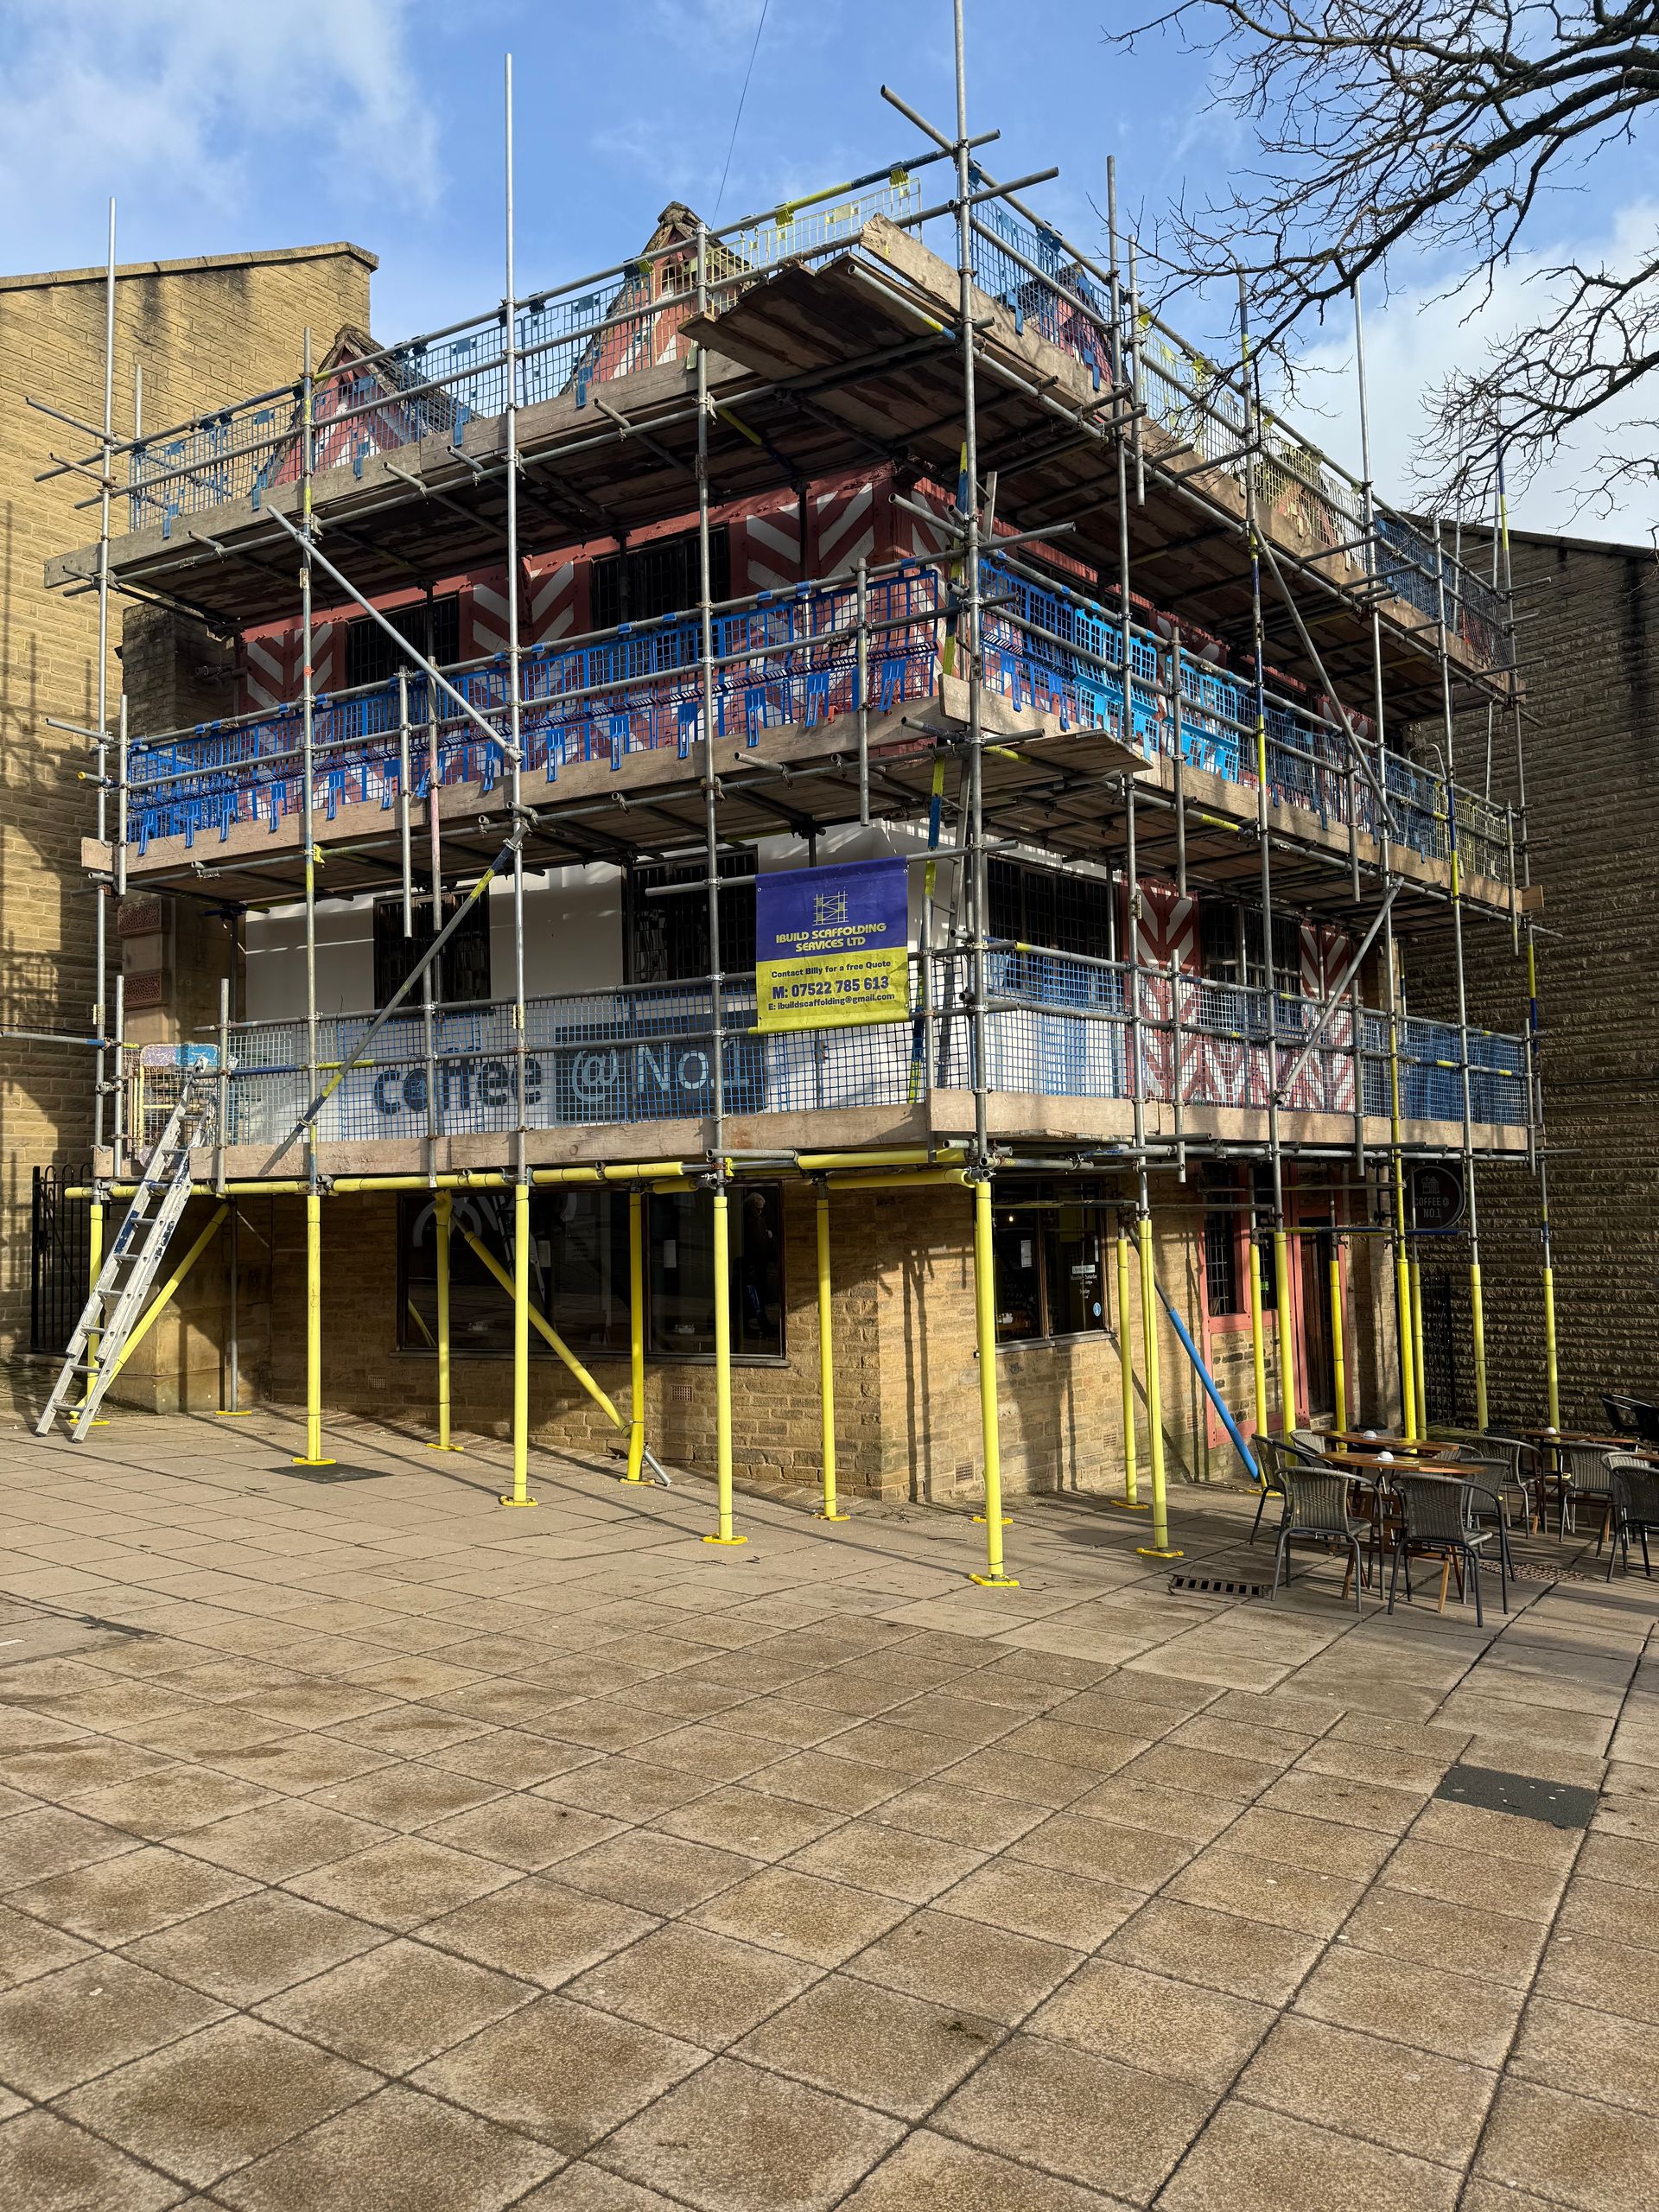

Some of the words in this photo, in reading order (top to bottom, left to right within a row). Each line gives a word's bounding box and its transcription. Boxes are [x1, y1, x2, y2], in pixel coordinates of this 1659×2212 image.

[776, 931, 810, 944] IBUILD
[811, 923, 887, 938] SCAFFOLDING
[795, 938, 844, 952] SERVICES
[846, 937, 866, 947] LTD
[772, 969, 804, 978] Contact
[805, 967, 823, 976] Billy
[866, 960, 892, 969] Quote
[772, 986, 788, 999] M:
[791, 982, 832, 997] 07522
[836, 978, 861, 993] 785
[864, 976, 889, 990] 613
[778, 994, 895, 1010] ibuildscaffolding@gmail.com
[1414, 1197, 1441, 1206] COFFEE
